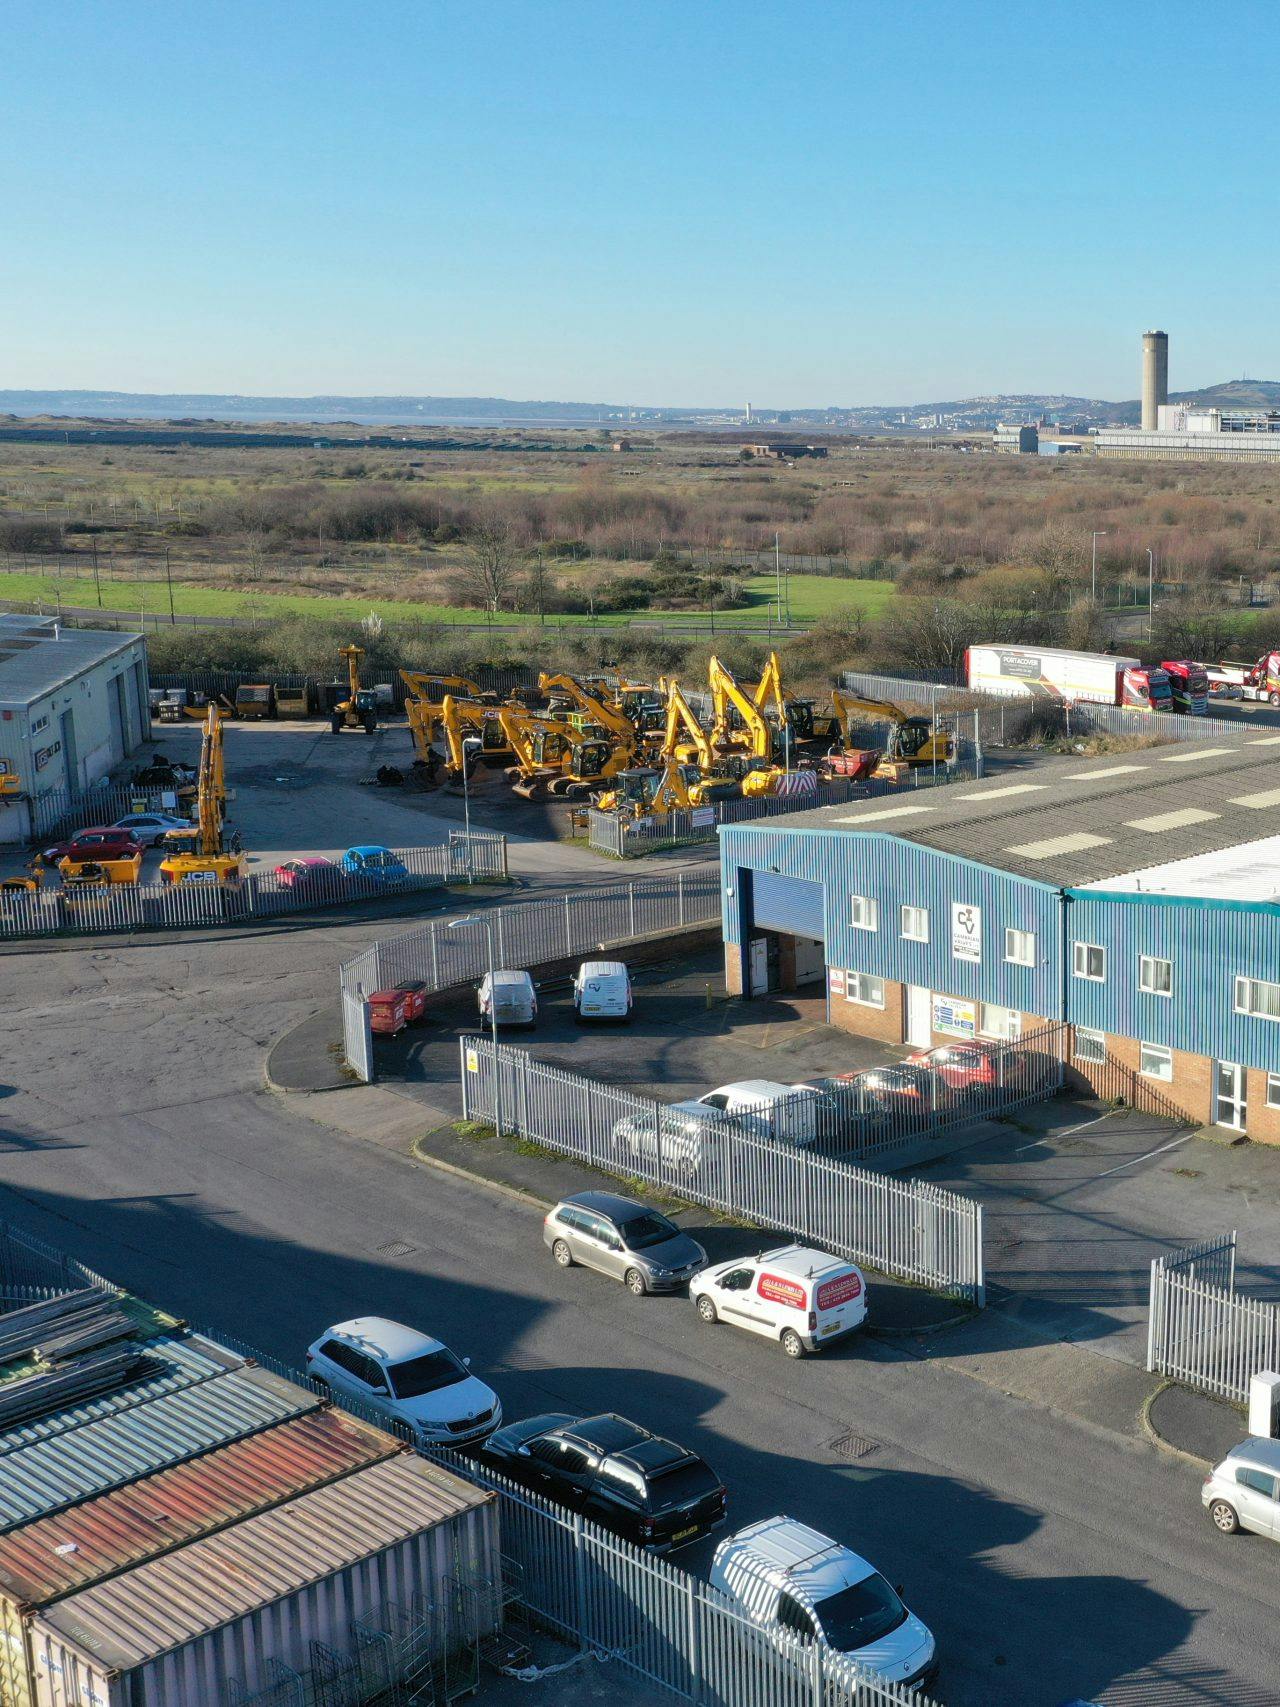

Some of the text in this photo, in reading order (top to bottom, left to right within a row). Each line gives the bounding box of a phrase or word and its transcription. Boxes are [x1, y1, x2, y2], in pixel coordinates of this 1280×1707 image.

[1003, 656, 1038, 666] PORTACOVER
[182, 871, 216, 881] JCB
[954, 933, 980, 942] CAMBRIAN
